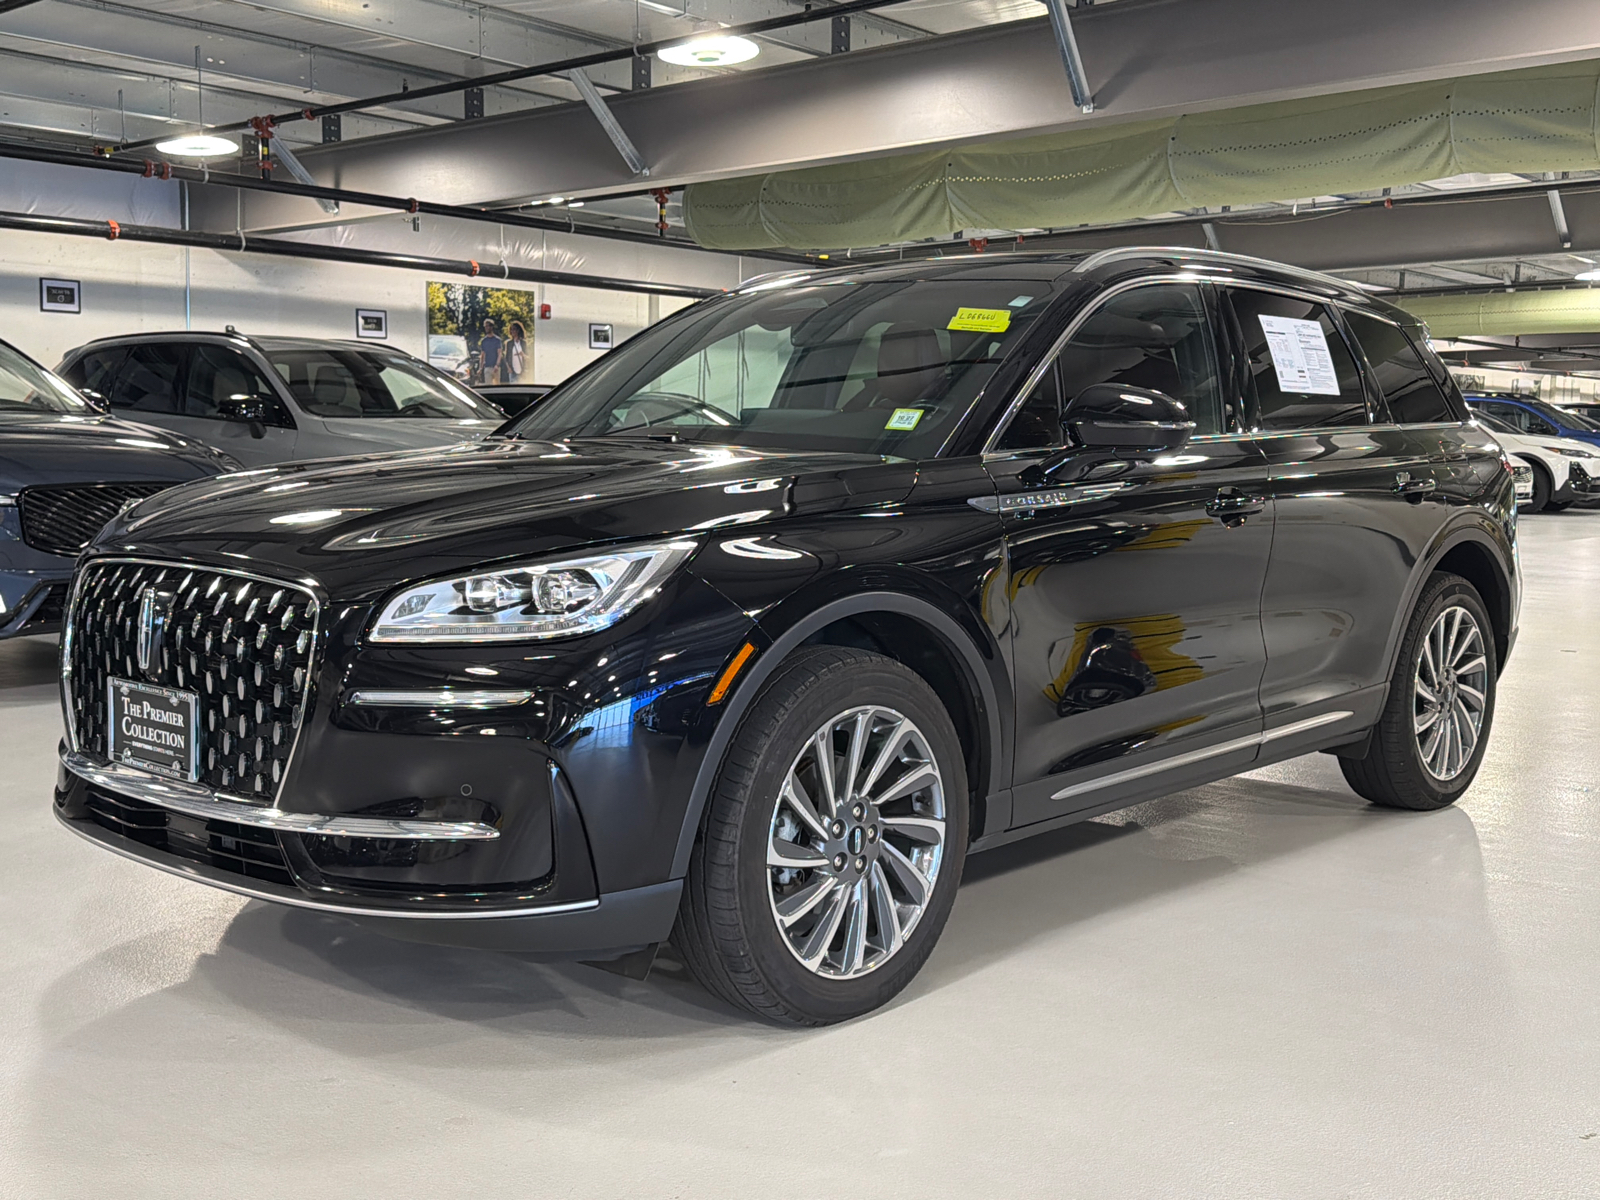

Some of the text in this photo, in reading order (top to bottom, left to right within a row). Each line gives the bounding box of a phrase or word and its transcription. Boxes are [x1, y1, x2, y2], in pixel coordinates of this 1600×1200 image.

[121, 697, 185, 727] THE PREMIER
[122, 716, 185, 749] COLLECTION
